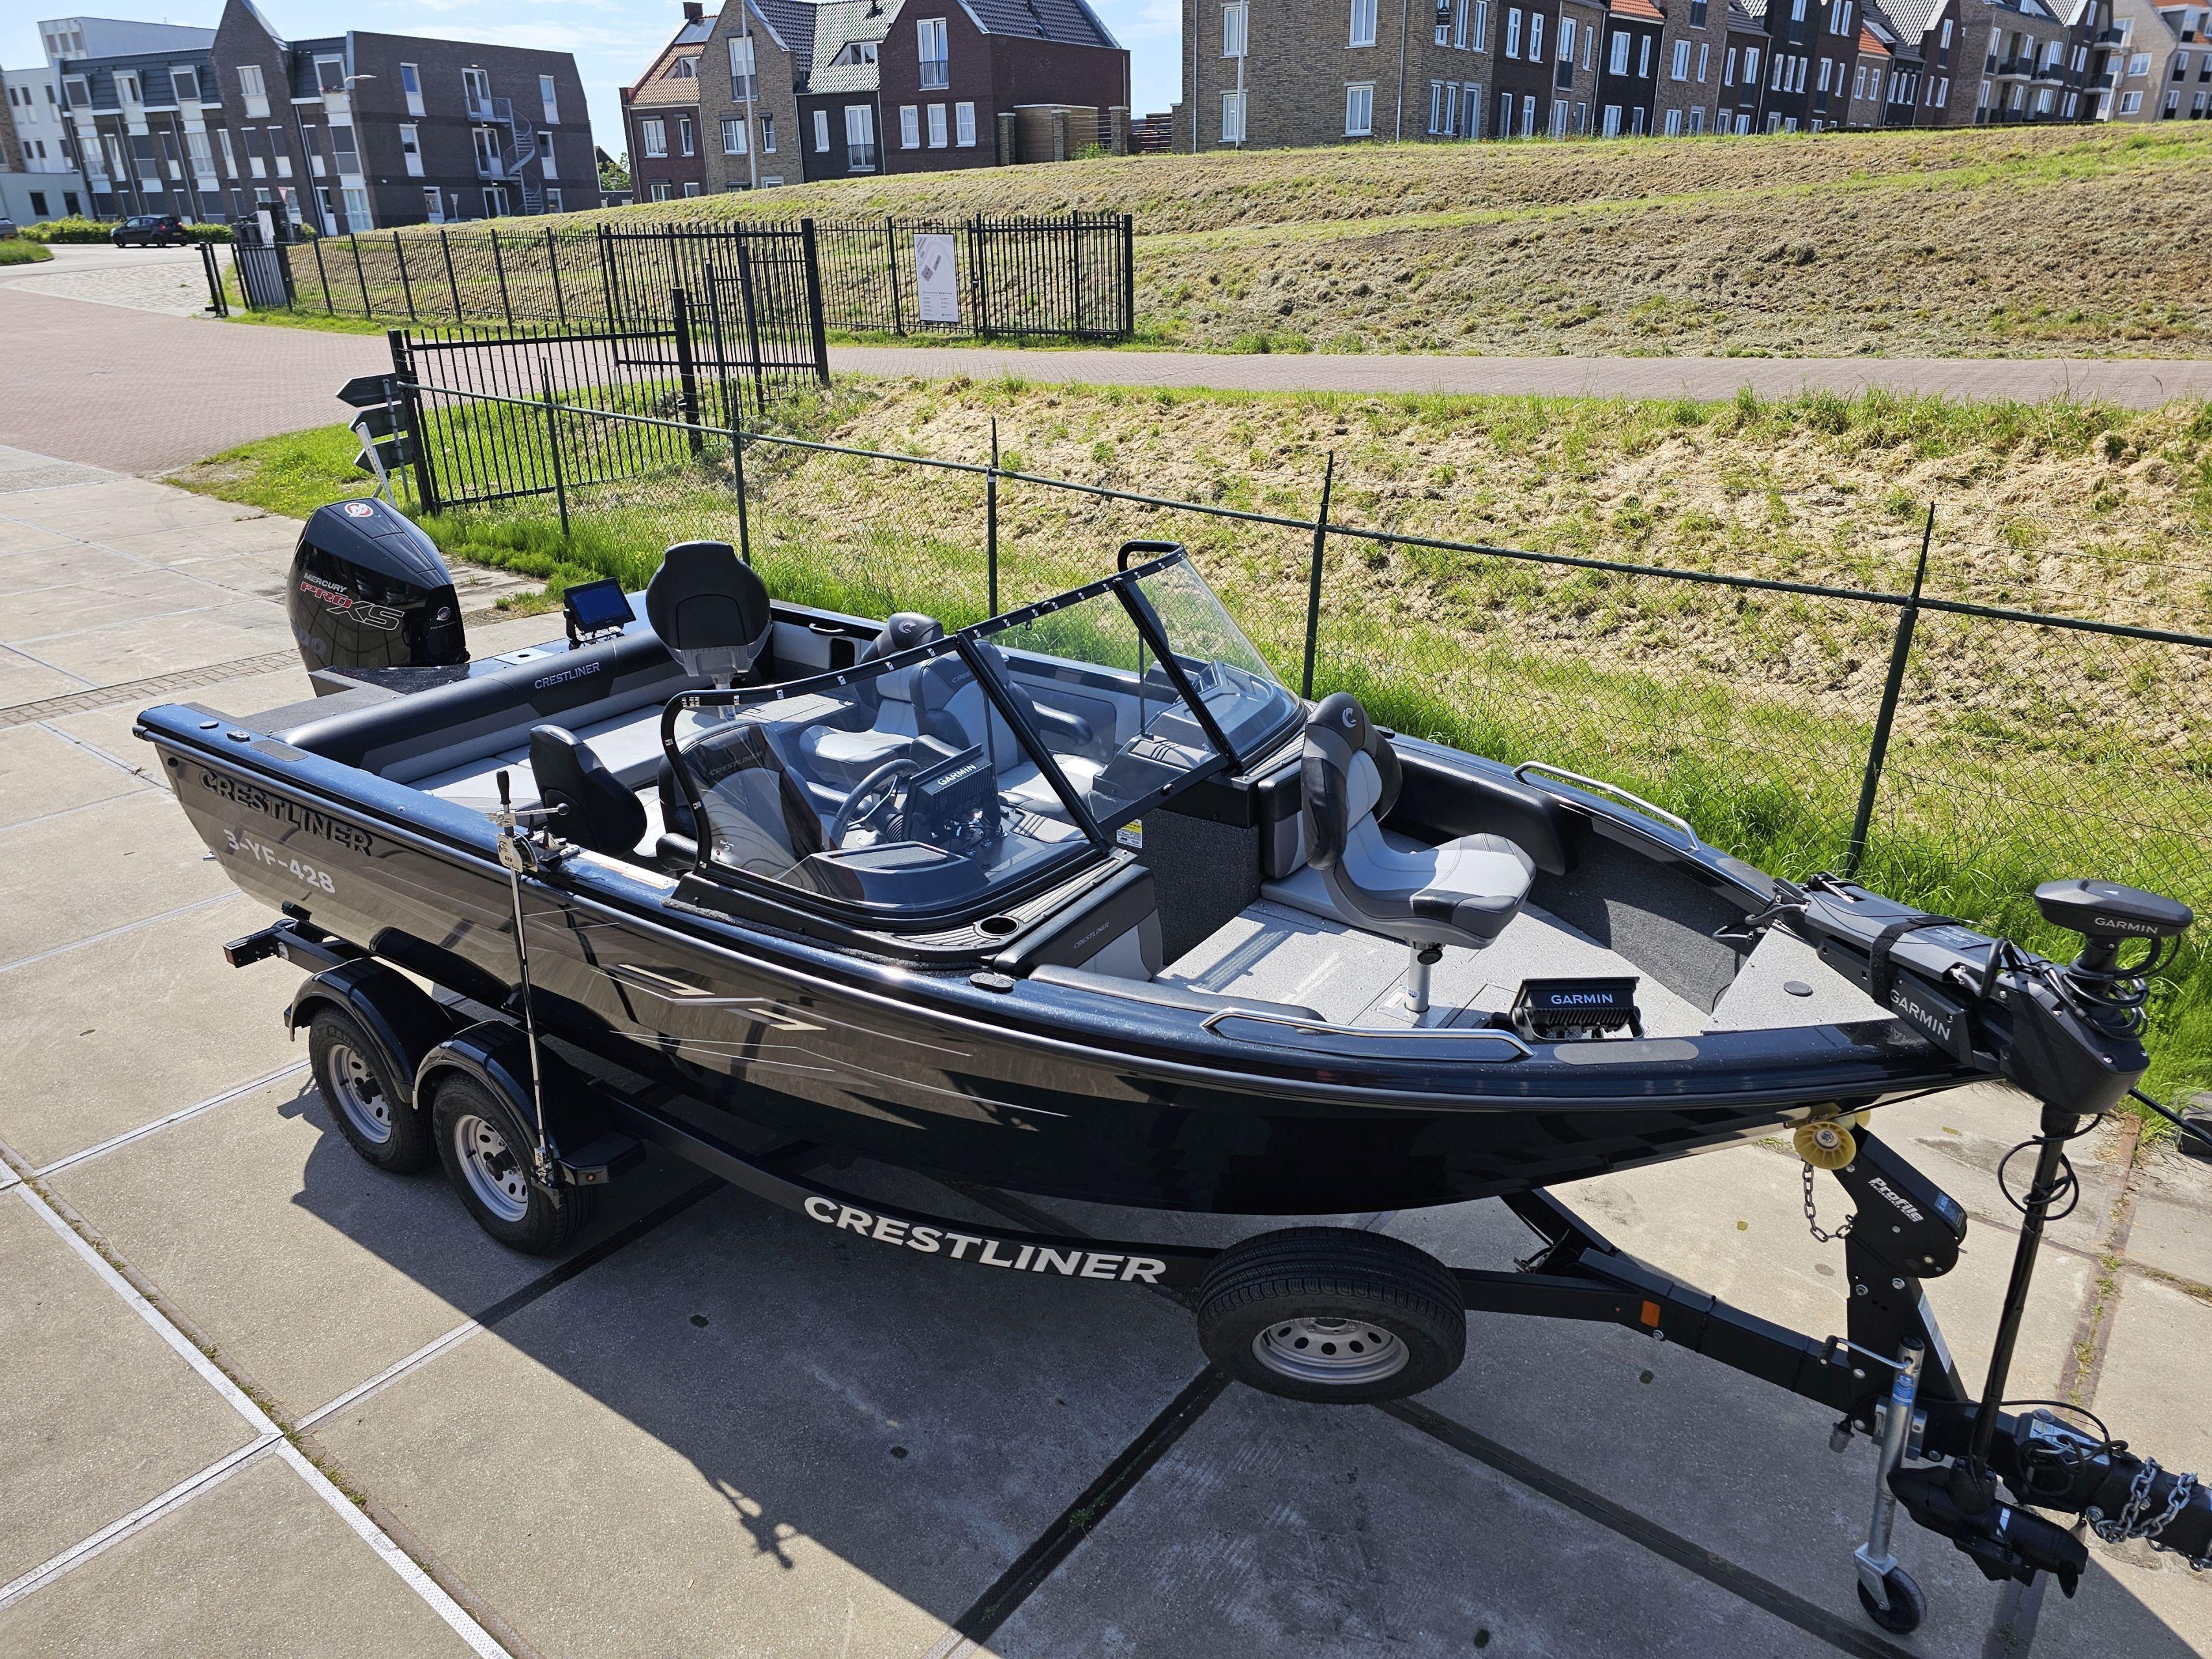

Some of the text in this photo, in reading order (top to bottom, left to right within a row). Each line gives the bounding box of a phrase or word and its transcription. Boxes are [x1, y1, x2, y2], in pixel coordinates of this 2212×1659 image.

[303, 572, 347, 593] MERCURY
[300, 581, 405, 631] PRO XS
[535, 662, 600, 690] CRESTLINER
[937, 763, 977, 785] GARMIN
[198, 767, 374, 857] CRESTLINER
[224, 829, 336, 894] 3-YF-428
[1073, 922, 1110, 949] CRESTLINER
[2094, 917, 2159, 934] GARMIN
[1550, 993, 1613, 1004] GARMIN
[1890, 989, 1950, 1041] GARMIN
[1870, 1177, 1924, 1221] Profile
[804, 1196, 1167, 1284] CRESTLINER
